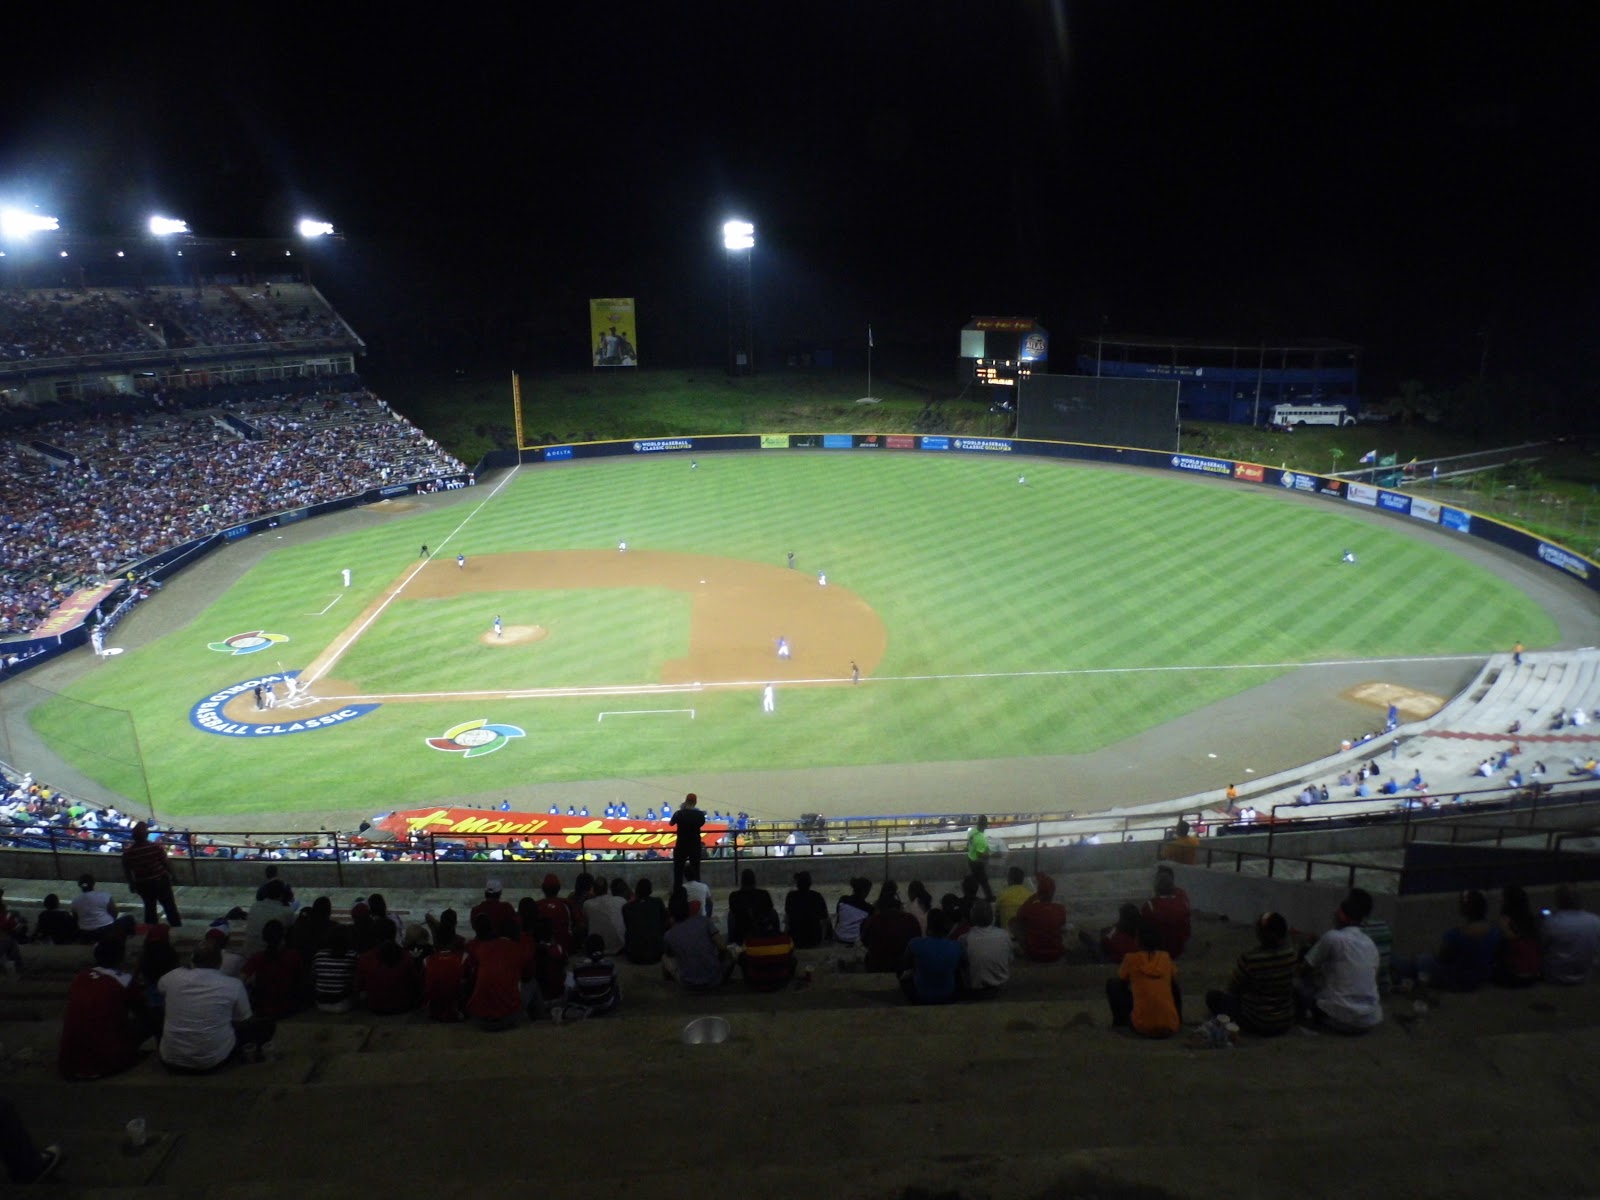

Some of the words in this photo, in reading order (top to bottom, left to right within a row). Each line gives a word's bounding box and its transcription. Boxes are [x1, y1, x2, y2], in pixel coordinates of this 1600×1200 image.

[1026, 341, 1044, 350] ATLAS
[1180, 462, 1202, 470] CLASSIC
[1200, 460, 1226, 468] BASEBALL
[228, 527, 247, 537] DELTA
[215, 675, 281, 703] WORLD
[196, 701, 247, 735] BASEBALL
[255, 709, 359, 734] CLASSIC
